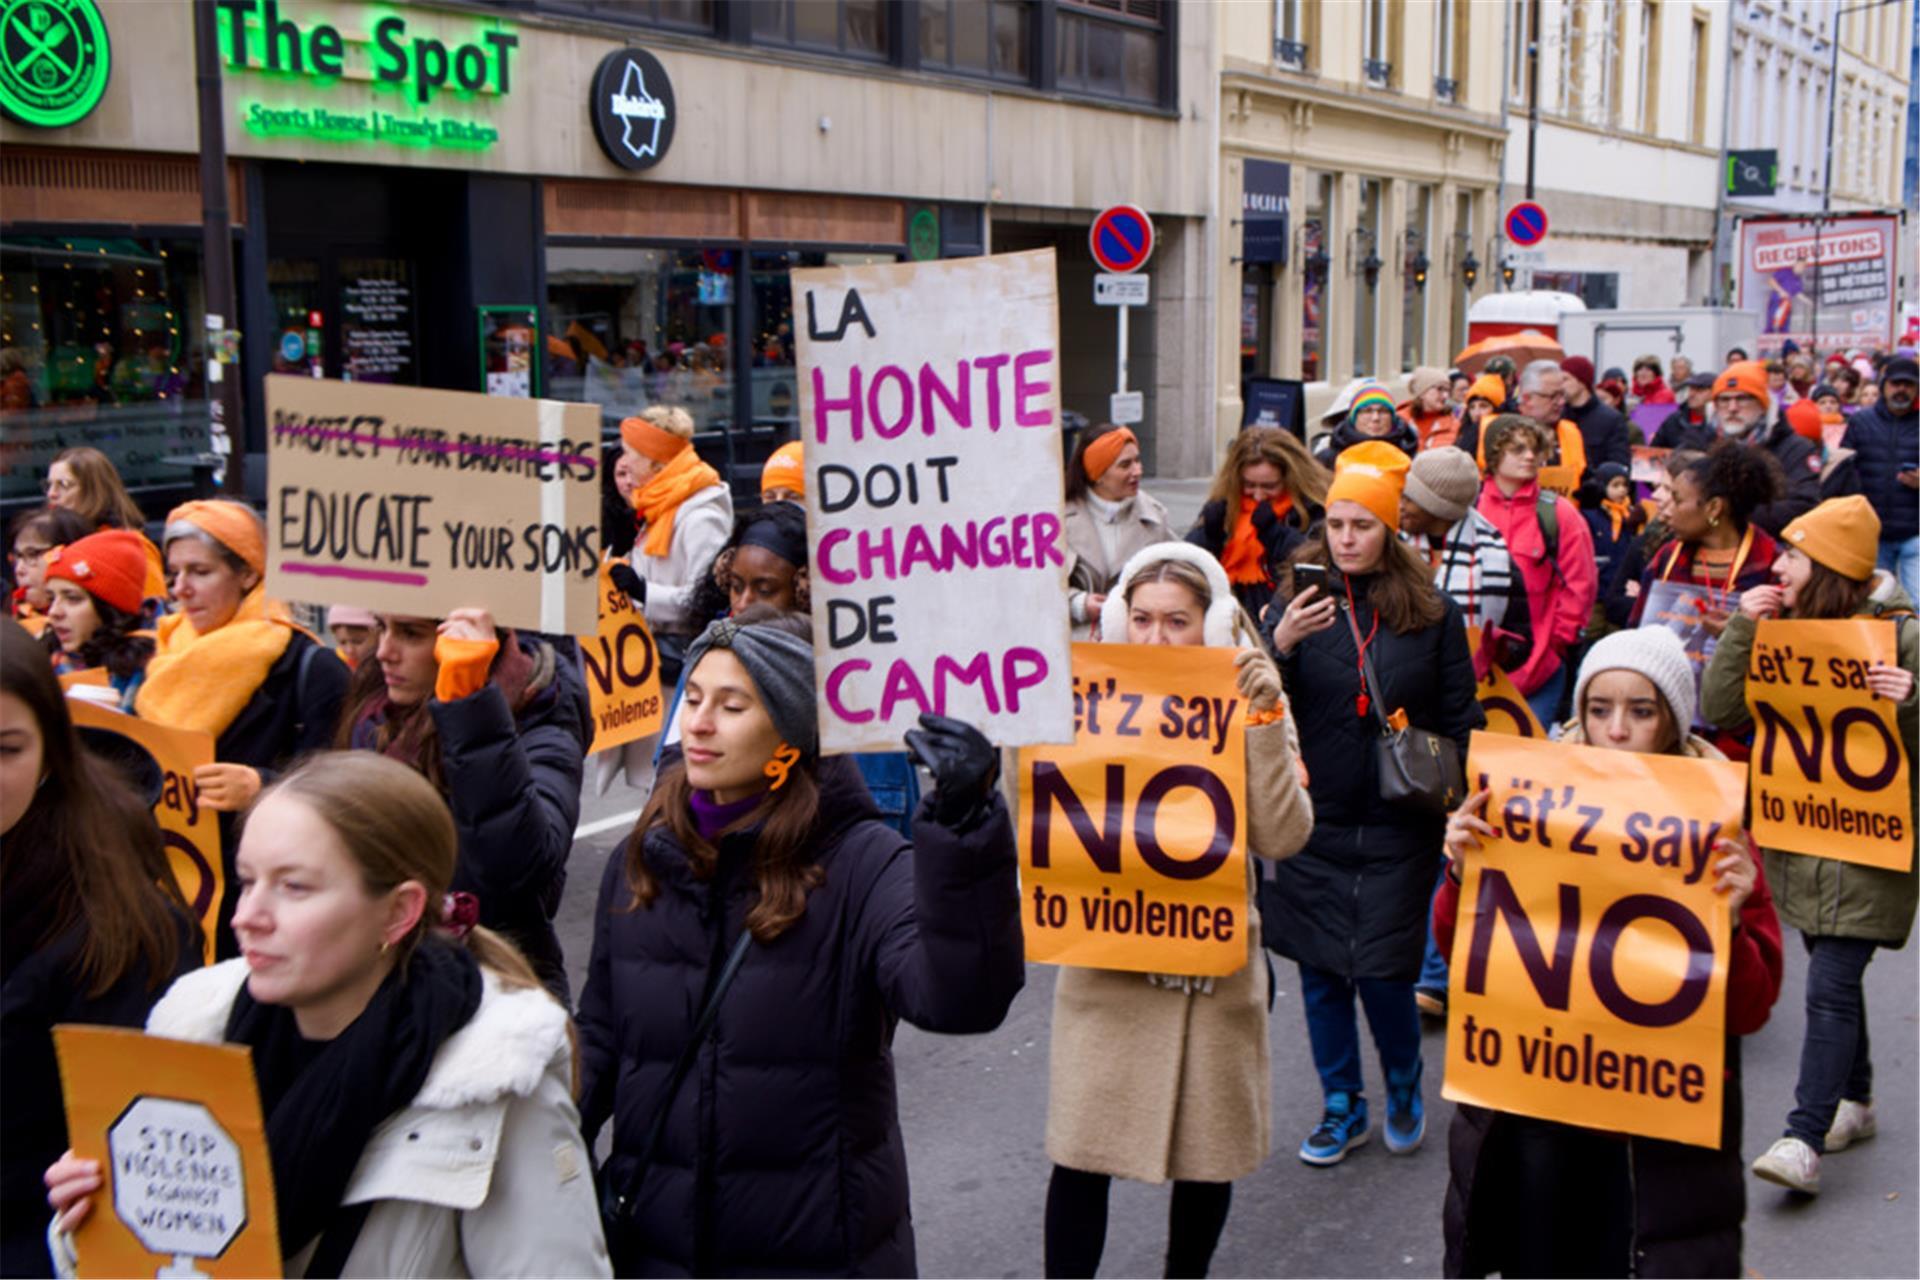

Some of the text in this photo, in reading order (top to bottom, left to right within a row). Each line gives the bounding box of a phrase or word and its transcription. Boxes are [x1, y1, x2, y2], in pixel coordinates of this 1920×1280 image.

[216, 0, 518, 103] The SpoT
[250, 104, 309, 129] Sports
[314, 109, 367, 131] House
[806, 287, 877, 342] LA
[812, 349, 1053, 445] HONTE
[274, 410, 385, 459] PROTECT
[817, 456, 958, 514] DOIT
[280, 486, 600, 579] EDUCATE YOUR SONS
[817, 512, 1065, 585] CHANGER
[827, 596, 898, 649] DE
[580, 623, 654, 696] NO
[825, 646, 1049, 724] CAMP
[600, 695, 659, 732] violence
[1160, 694, 1238, 754] say
[1755, 700, 1900, 792] NO
[158, 770, 199, 827] ay
[1030, 760, 1236, 881] NO
[1761, 790, 1903, 842] to violence
[1621, 810, 1723, 885] say
[1033, 886, 1235, 942] to violence
[1464, 868, 1715, 1029] NO
[1463, 1015, 1706, 1103] to violence
[119, 1151, 236, 1189] VIOLENCE
[140, 1125, 216, 1157] STOP
[135, 1206, 226, 1235] WOMEN
[146, 1182, 220, 1207] AGAINST
